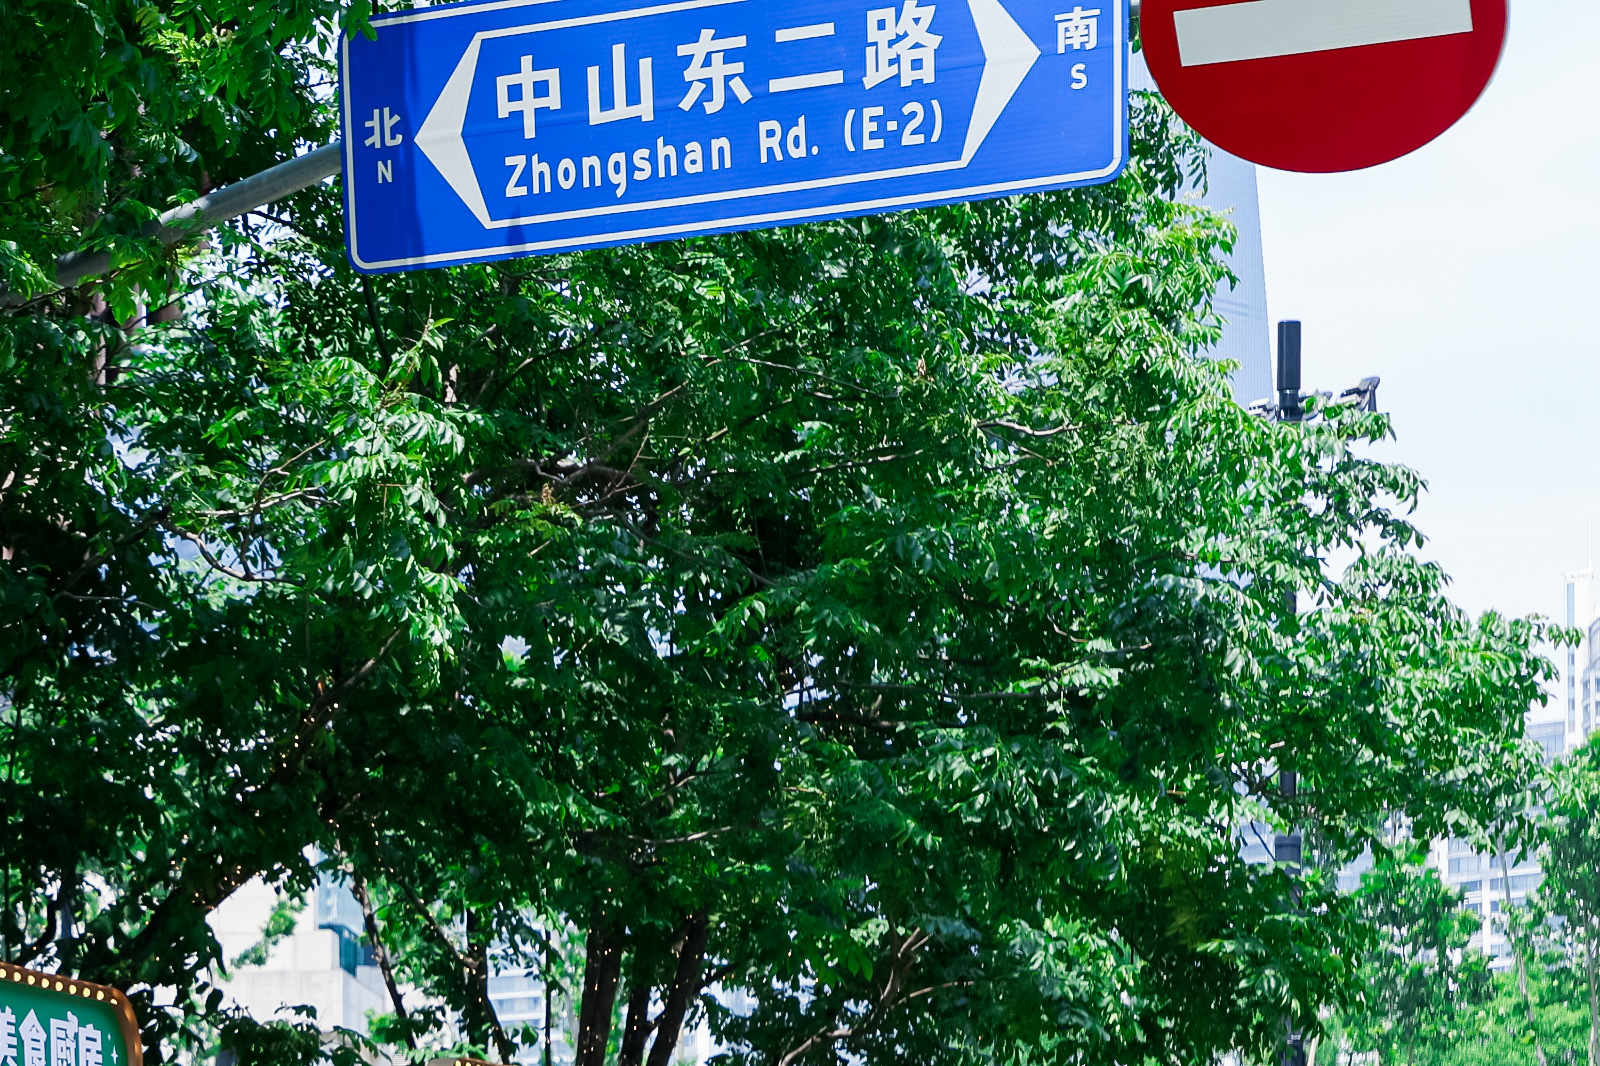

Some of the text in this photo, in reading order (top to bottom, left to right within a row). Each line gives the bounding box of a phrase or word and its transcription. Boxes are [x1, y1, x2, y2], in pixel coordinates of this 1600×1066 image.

[1055, 6, 1099, 54] 南
[496, 0, 942, 139] 中山东二路
[1071, 63, 1087, 91] S
[363, 106, 403, 149] 北
[504, 99, 942, 199] Zhongshan Rd. (E-2)
[377, 160, 393, 184] N
